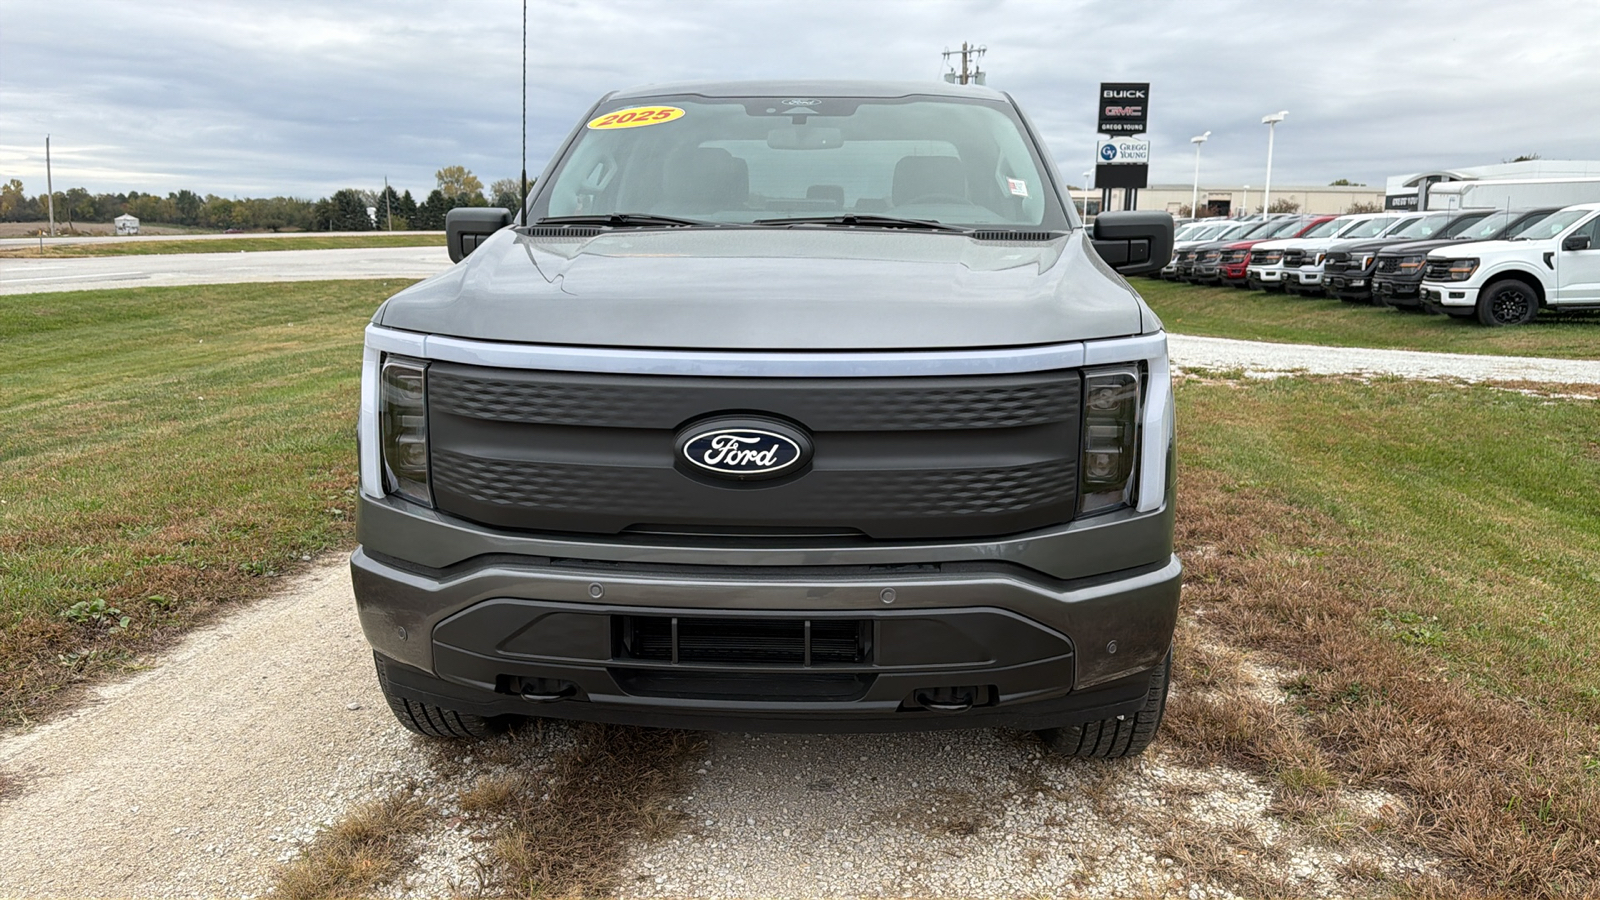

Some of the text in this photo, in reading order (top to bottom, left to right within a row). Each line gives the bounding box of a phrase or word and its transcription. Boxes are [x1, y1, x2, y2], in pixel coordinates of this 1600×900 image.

[1103, 90, 1145, 98] BUICK
[1105, 106, 1142, 116] GMC
[596, 109, 676, 127] 2025
[1119, 143, 1146, 151] GREGG
[1120, 151, 1146, 159] YOUNG
[704, 435, 779, 466] Ford
